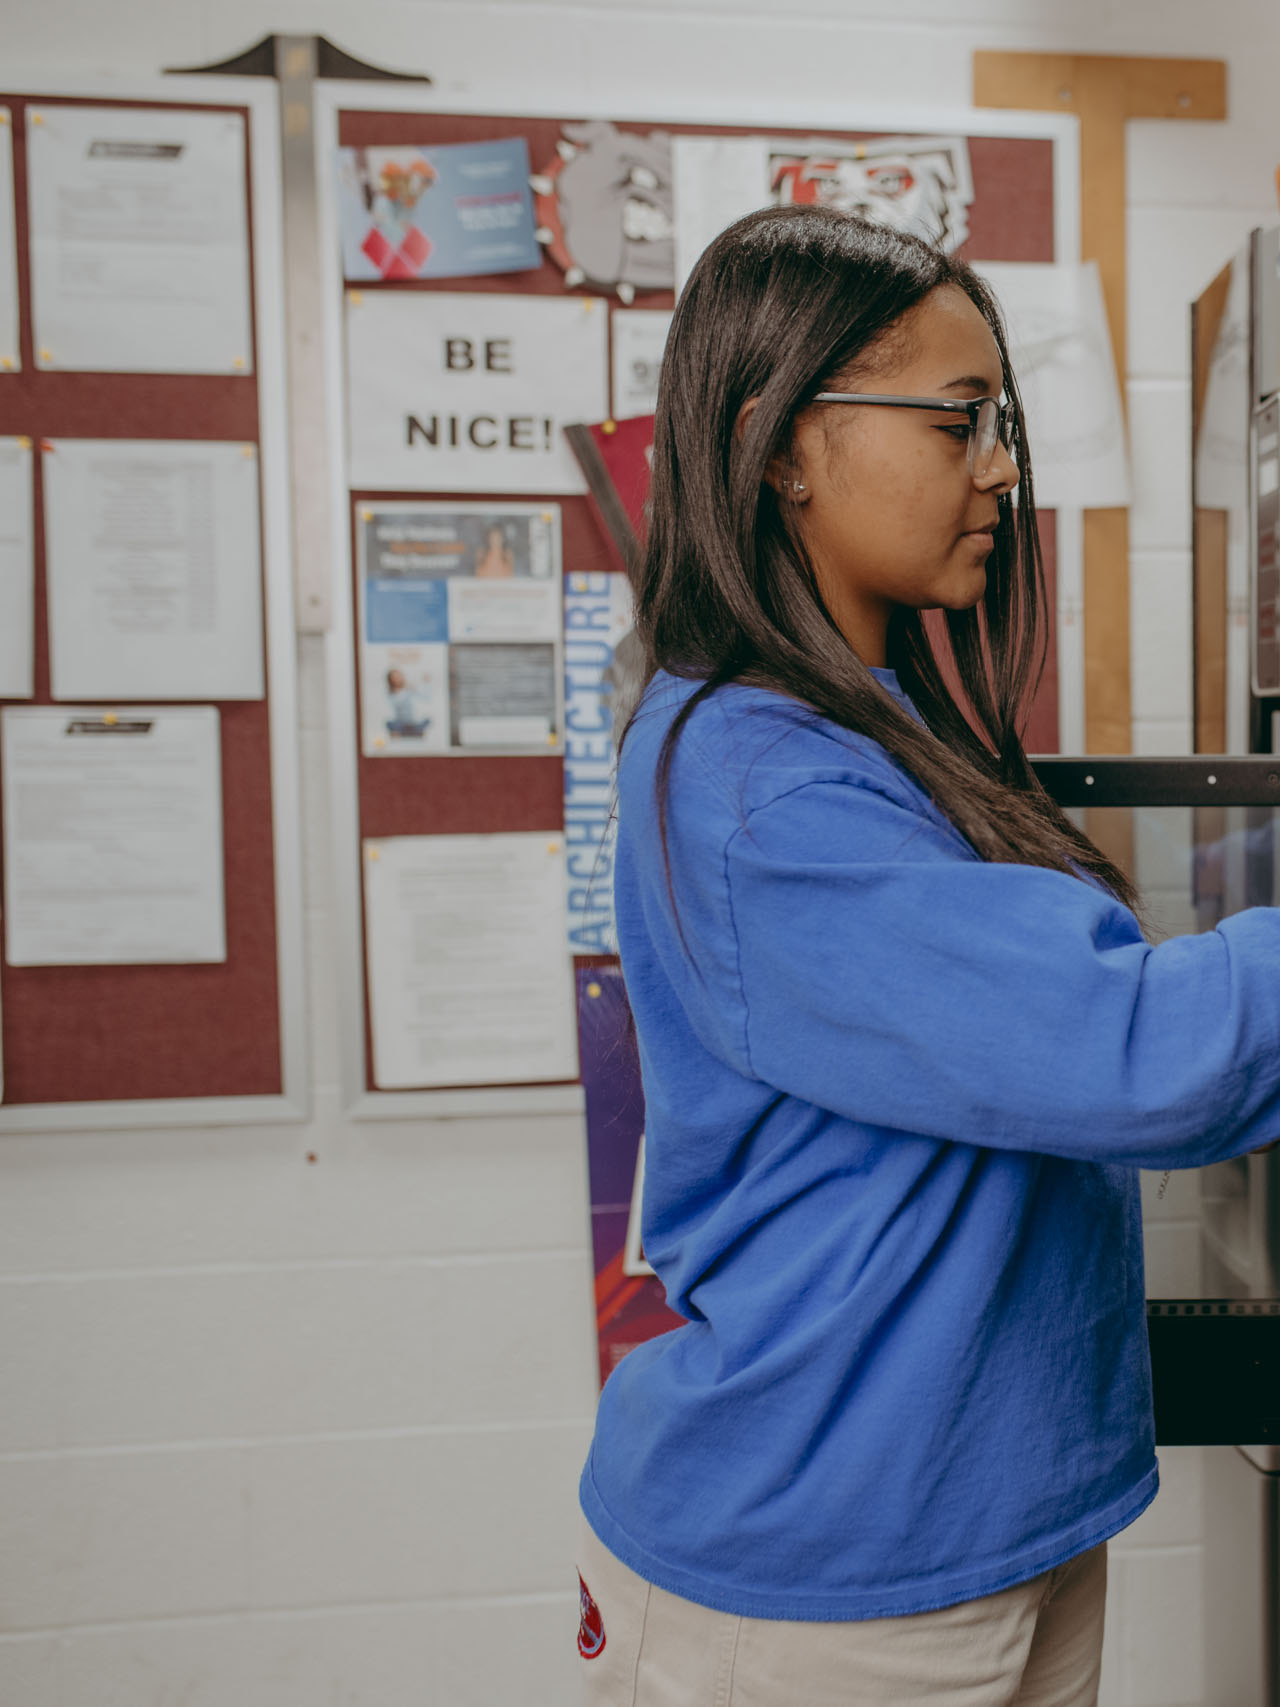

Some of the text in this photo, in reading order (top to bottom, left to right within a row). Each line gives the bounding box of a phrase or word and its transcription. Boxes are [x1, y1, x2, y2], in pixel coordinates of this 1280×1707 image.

[445, 339, 513, 374] BE
[406, 415, 553, 451] NICE!
[564, 572, 613, 953] ARCHITECTURE
